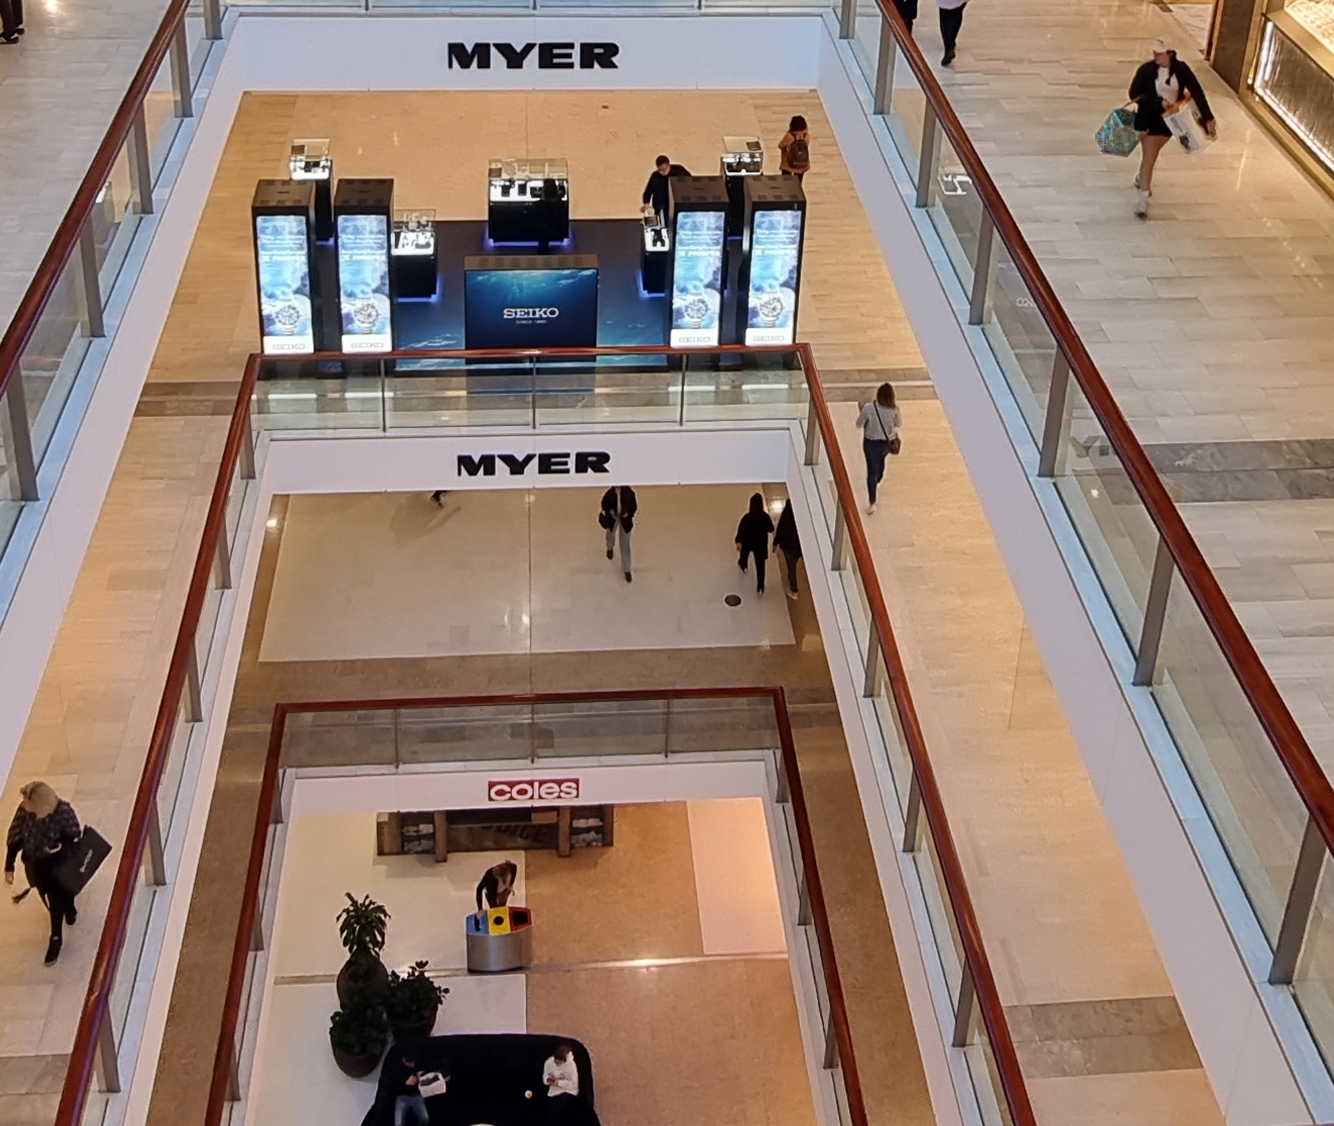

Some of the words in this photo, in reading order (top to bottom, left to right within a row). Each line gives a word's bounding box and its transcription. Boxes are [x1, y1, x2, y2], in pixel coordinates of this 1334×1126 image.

[447, 42, 620, 70] MYER
[503, 307, 559, 319] SEIKO
[457, 451, 611, 476] MYER
[490, 781, 578, 801] coles
